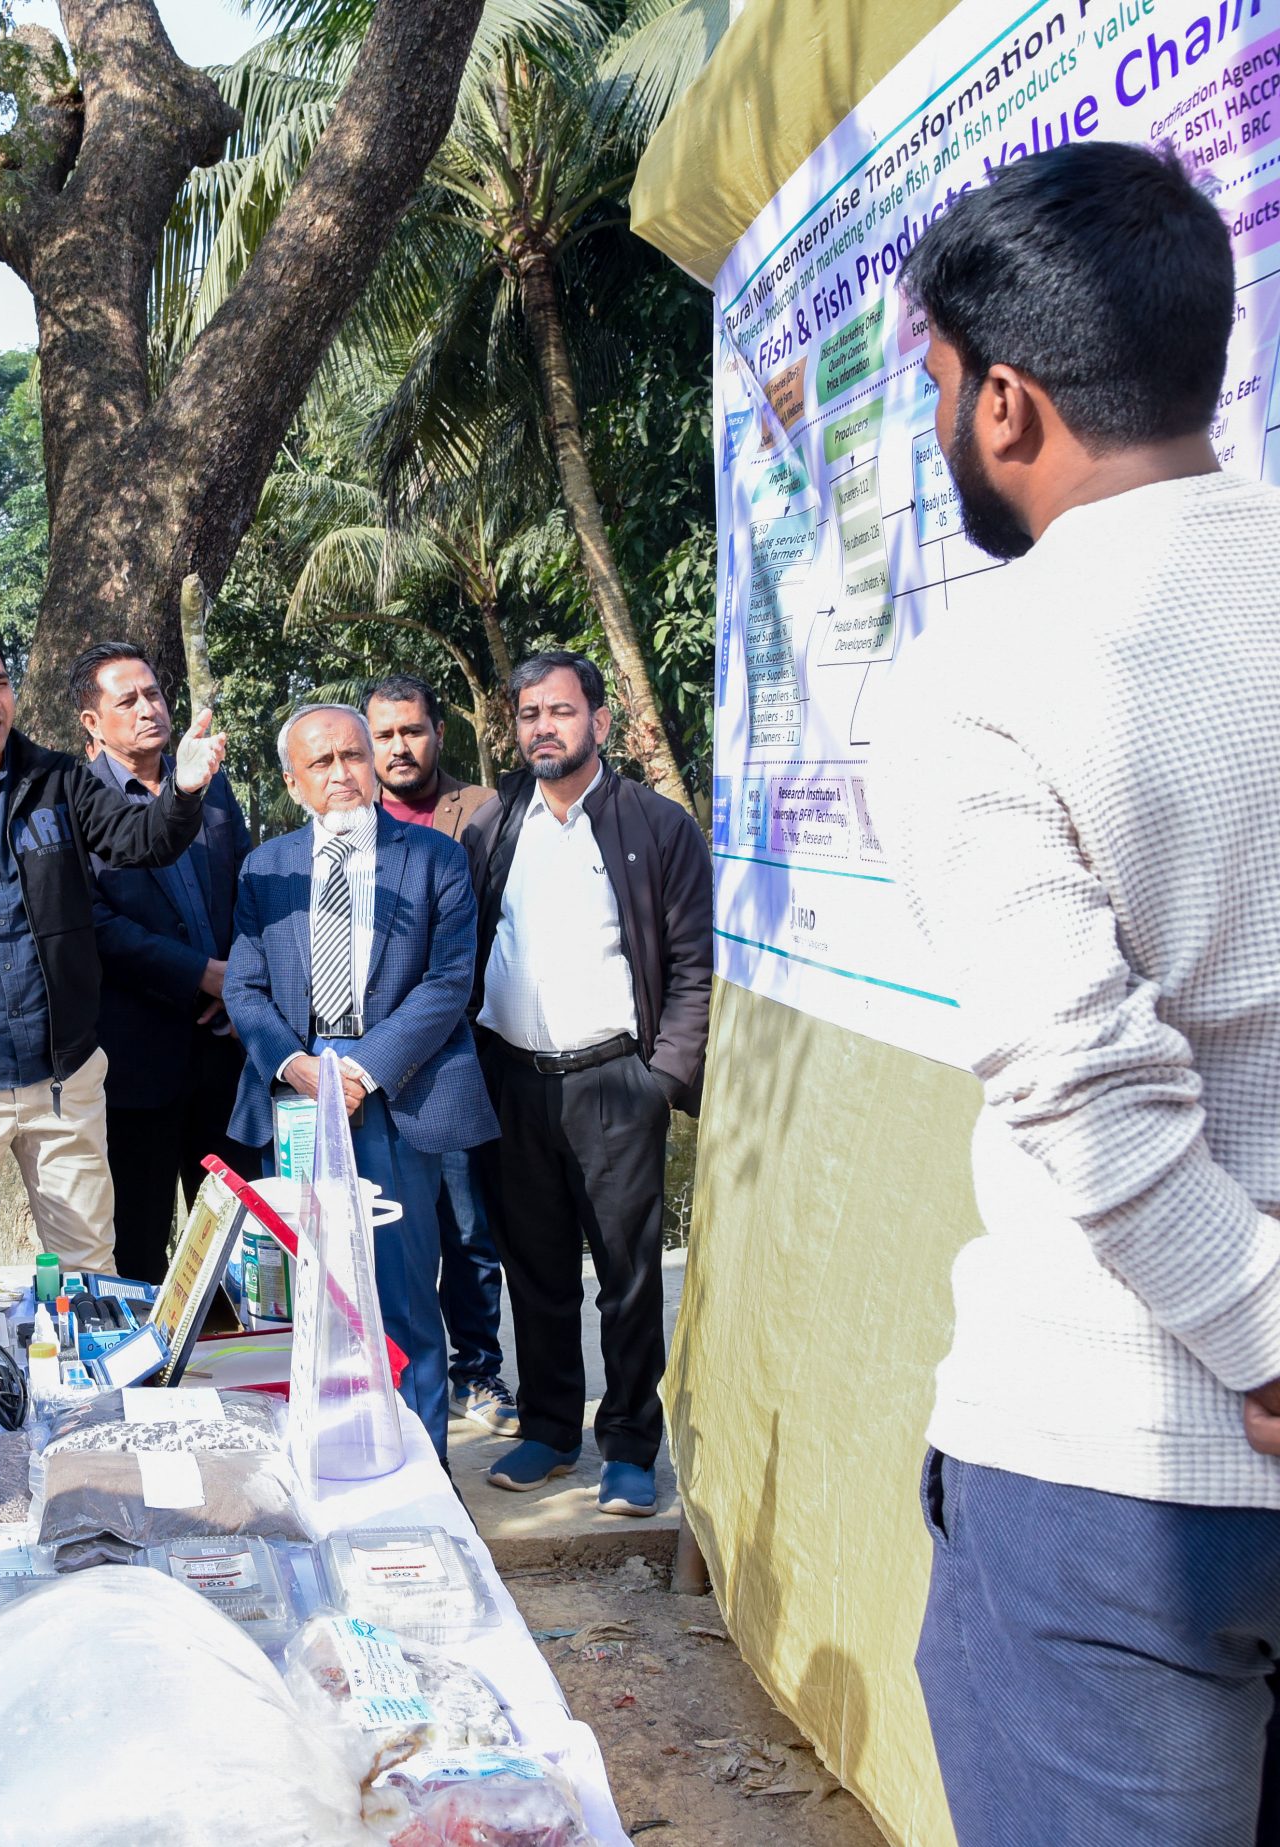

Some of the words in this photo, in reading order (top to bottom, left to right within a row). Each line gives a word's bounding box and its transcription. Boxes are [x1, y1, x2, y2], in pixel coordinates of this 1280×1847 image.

[1150, 80, 1217, 140] Certification
[1185, 108, 1222, 143] BSTI,
[1192, 130, 1238, 168] Halal,
[1241, 110, 1271, 144] BRC
[725, 298, 752, 332] Rural
[753, 188, 860, 306] Microenterprise
[865, 13, 1065, 193] Transformation
[765, 283, 799, 326] Production
[800, 259, 815, 290] and
[817, 220, 864, 275] marketing
[865, 202, 877, 230] of
[879, 186, 903, 219] safe
[905, 160, 930, 196] fish
[933, 132, 960, 175] and
[963, 110, 992, 150] fish
[1094, 0, 1155, 49] value
[759, 325, 792, 375] Fish
[796, 309, 812, 345] &
[813, 273, 852, 331] Fish
[839, 321, 865, 351] Marketing
[1237, 375, 1261, 399] Eat:
[834, 417, 869, 444] Producers
[916, 445, 933, 465] Ready
[922, 492, 939, 514] Ready
[941, 492, 948, 506] to
[948, 487, 959, 503] Ea
[775, 533, 806, 546] service
[807, 531, 815, 542] to
[770, 548, 804, 561] farmers
[723, 575, 732, 633] Market
[853, 618, 868, 631] River
[835, 638, 872, 651] Developers
[755, 652, 765, 664] Kit
[778, 786, 805, 800] Research
[806, 787, 836, 801] Institution
[803, 830, 832, 845] Research
[798, 907, 816, 931] IFAD
